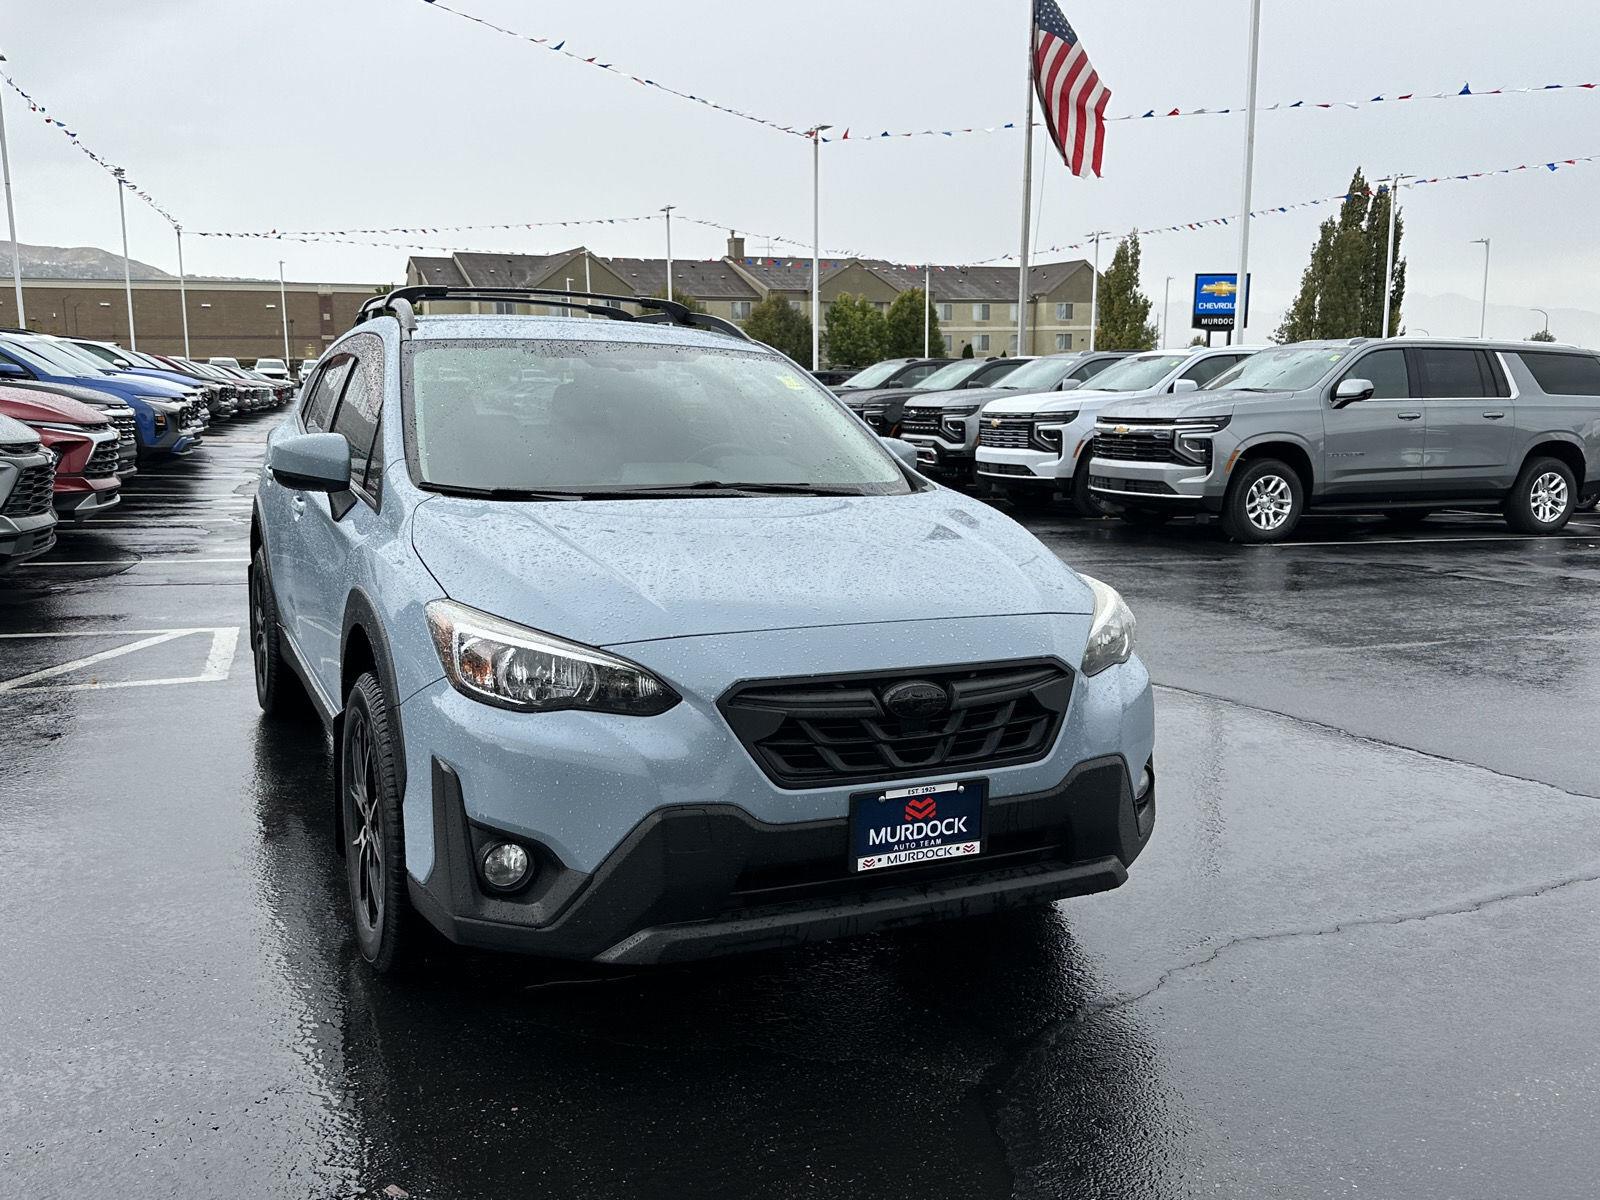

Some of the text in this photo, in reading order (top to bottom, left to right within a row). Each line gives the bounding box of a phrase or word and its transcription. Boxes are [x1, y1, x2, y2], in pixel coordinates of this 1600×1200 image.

[869, 816, 967, 845] MURDOCK
[893, 838, 942, 851] AUTO TEAM
[887, 847, 952, 864] MURDOCK
